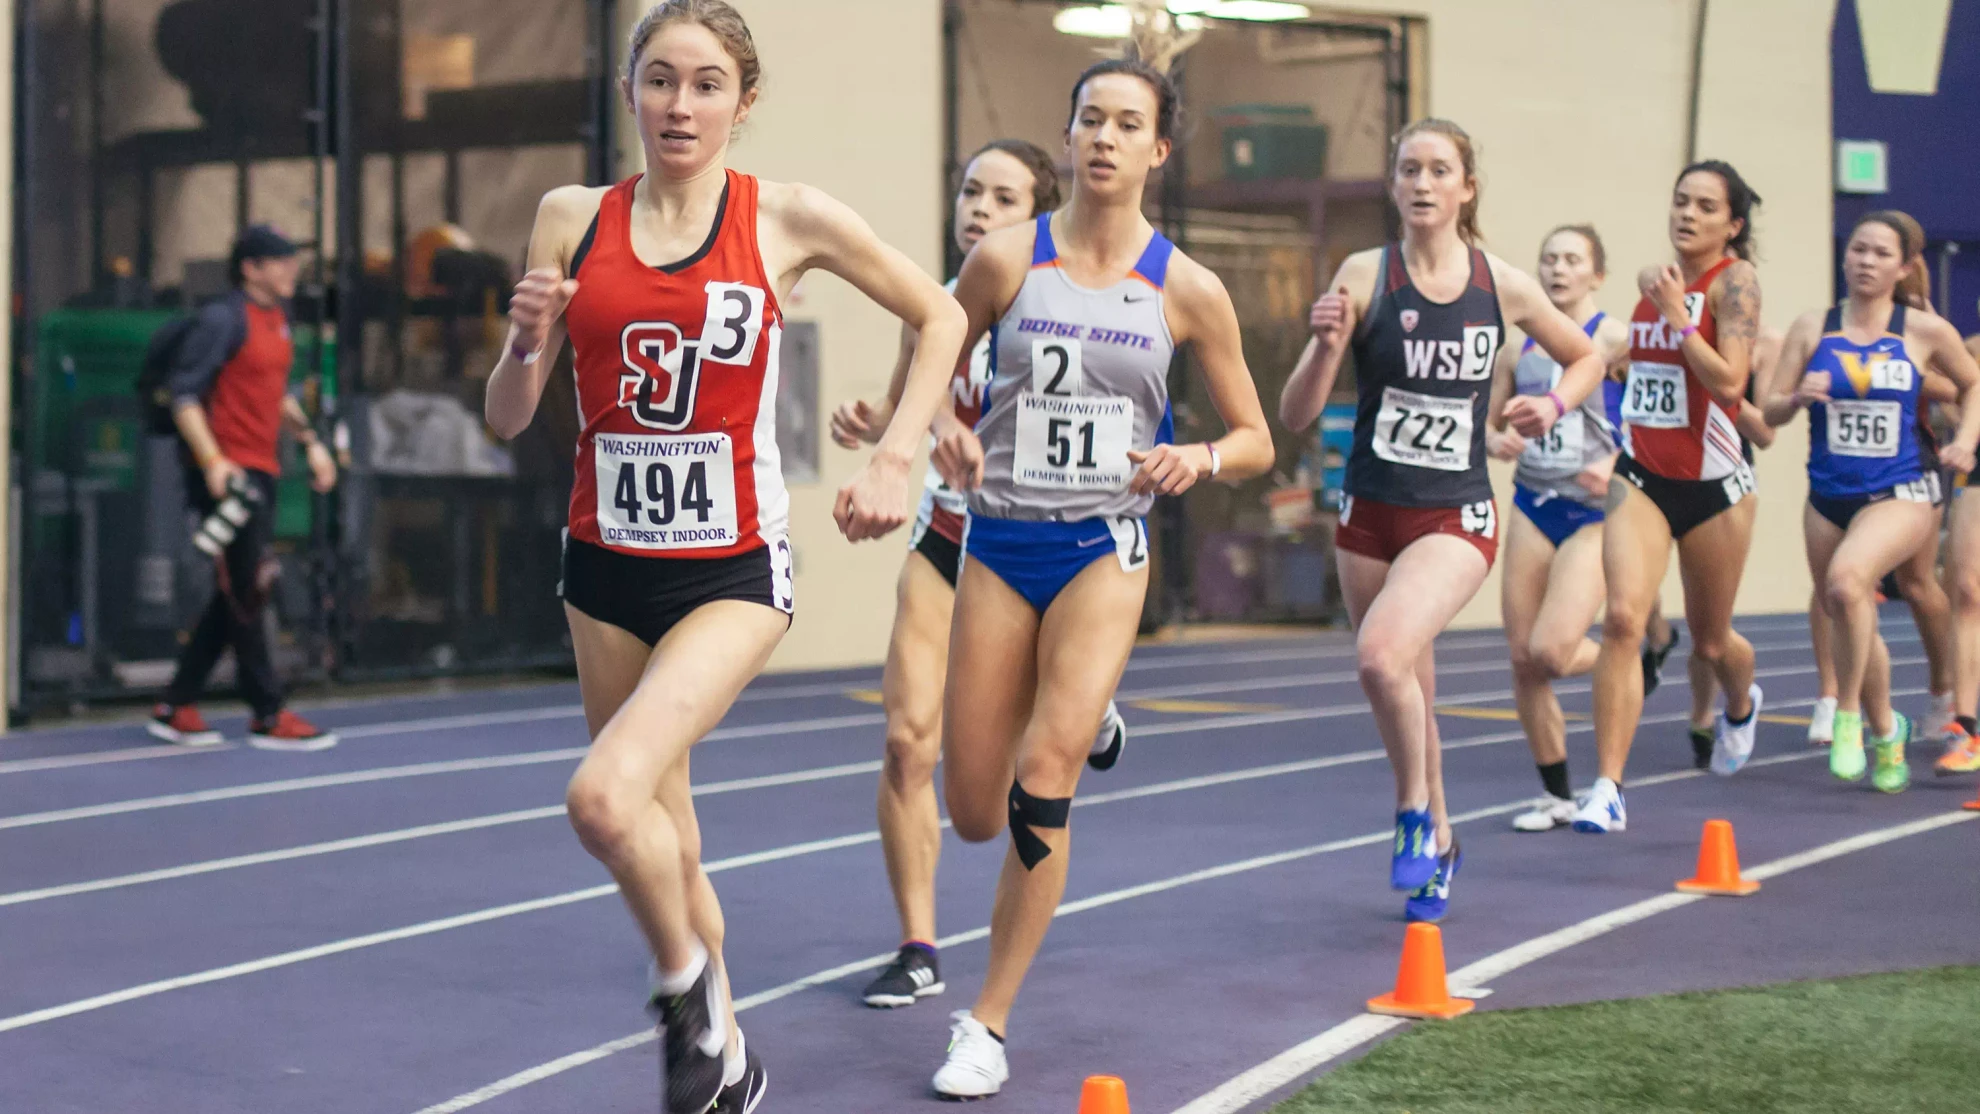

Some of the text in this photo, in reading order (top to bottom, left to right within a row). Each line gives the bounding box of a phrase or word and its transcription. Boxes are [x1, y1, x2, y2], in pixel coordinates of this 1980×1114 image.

[711, 290, 753, 360] 3
[1017, 317, 1154, 350] BOISE STATE
[1042, 345, 1072, 397] 2
[1403, 339, 1463, 380] WS
[1473, 331, 1490, 376] 9
[618, 321, 702, 432] SU
[1632, 378, 1676, 414] 658
[1025, 397, 1125, 415] WASHINGTON
[602, 440, 721, 456] WASHINGTON
[1046, 418, 1097, 468] 51
[1390, 407, 1457, 453] 722
[1838, 412, 1888, 444] 556
[614, 461, 714, 526] 494
[1023, 469, 1122, 485] DEMPSEY INDOOR
[607, 527, 727, 543] DEMPSEY INDOOR
[1470, 501, 1489, 532] 9
[1115, 513, 1145, 566] 2
